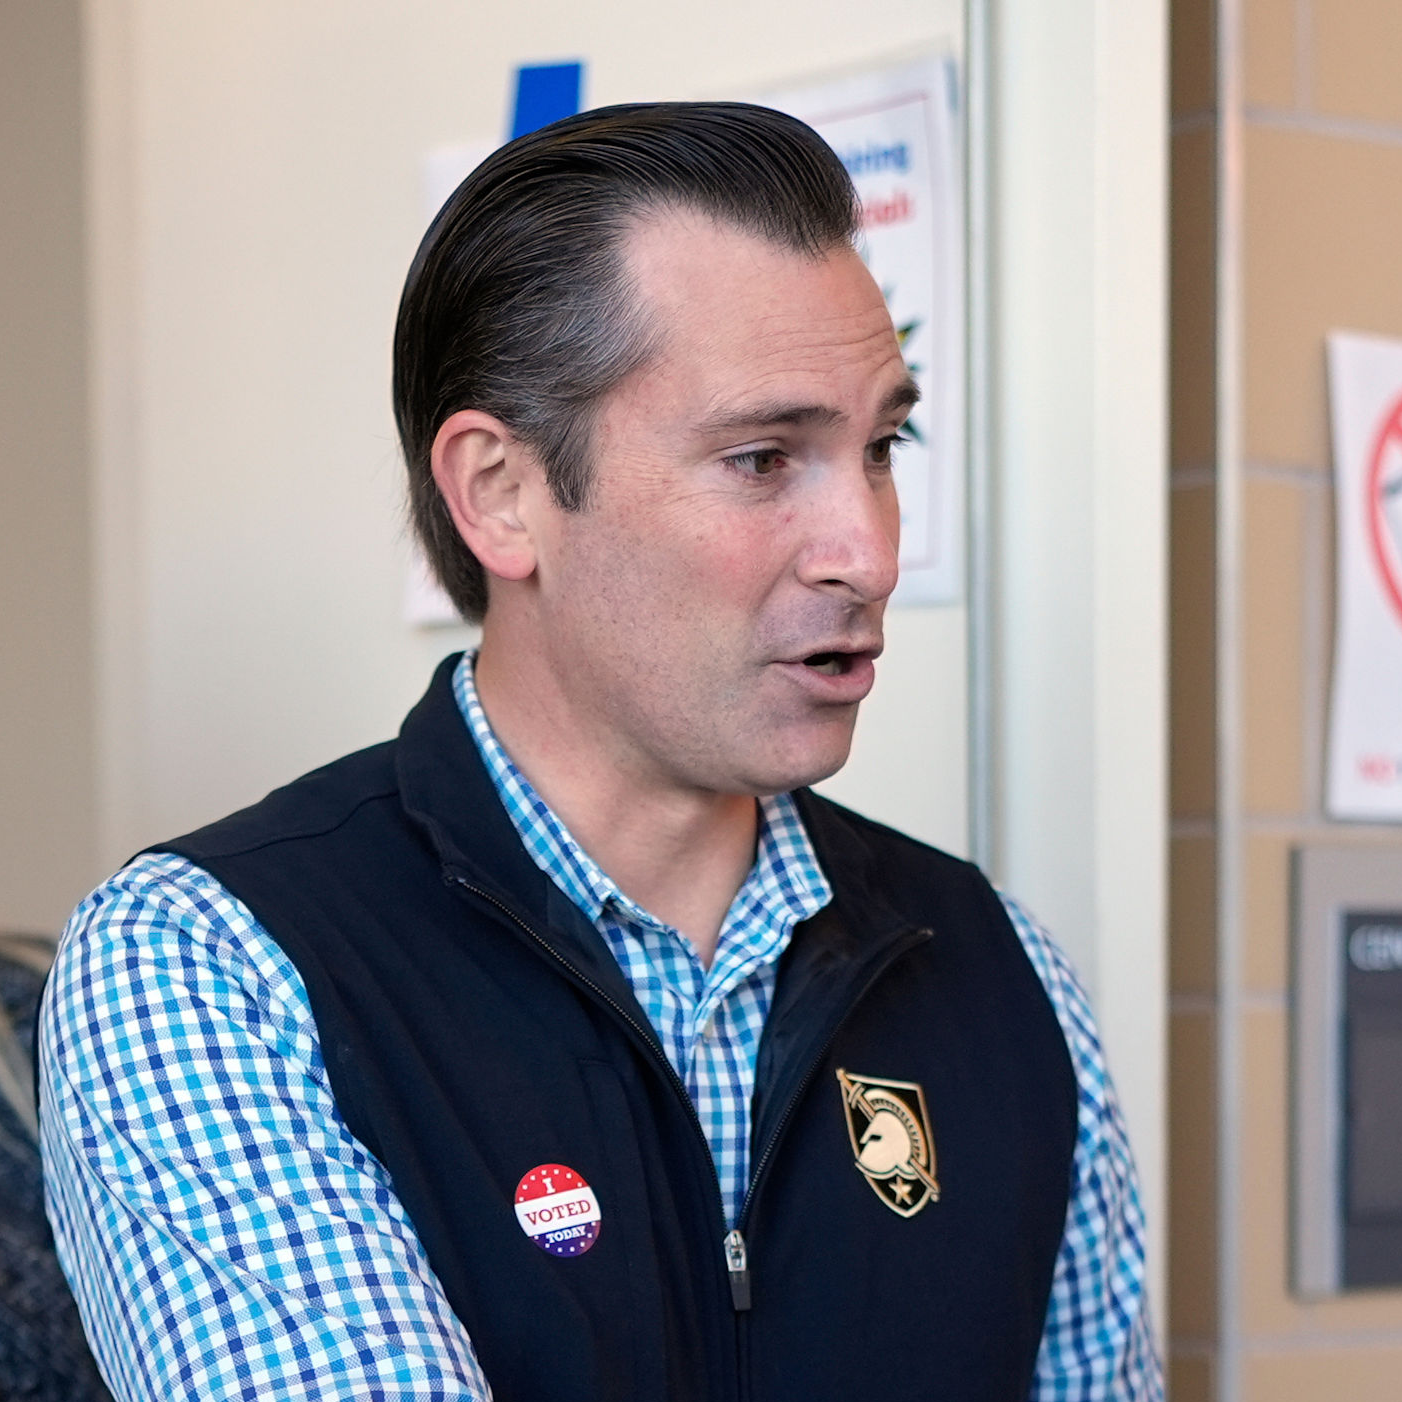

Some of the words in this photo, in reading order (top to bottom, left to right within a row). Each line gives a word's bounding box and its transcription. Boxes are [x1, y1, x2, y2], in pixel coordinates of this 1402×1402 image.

[542, 1177, 555, 1194] I
[524, 1199, 591, 1226] VOTED
[546, 1226, 586, 1244] TODAY
